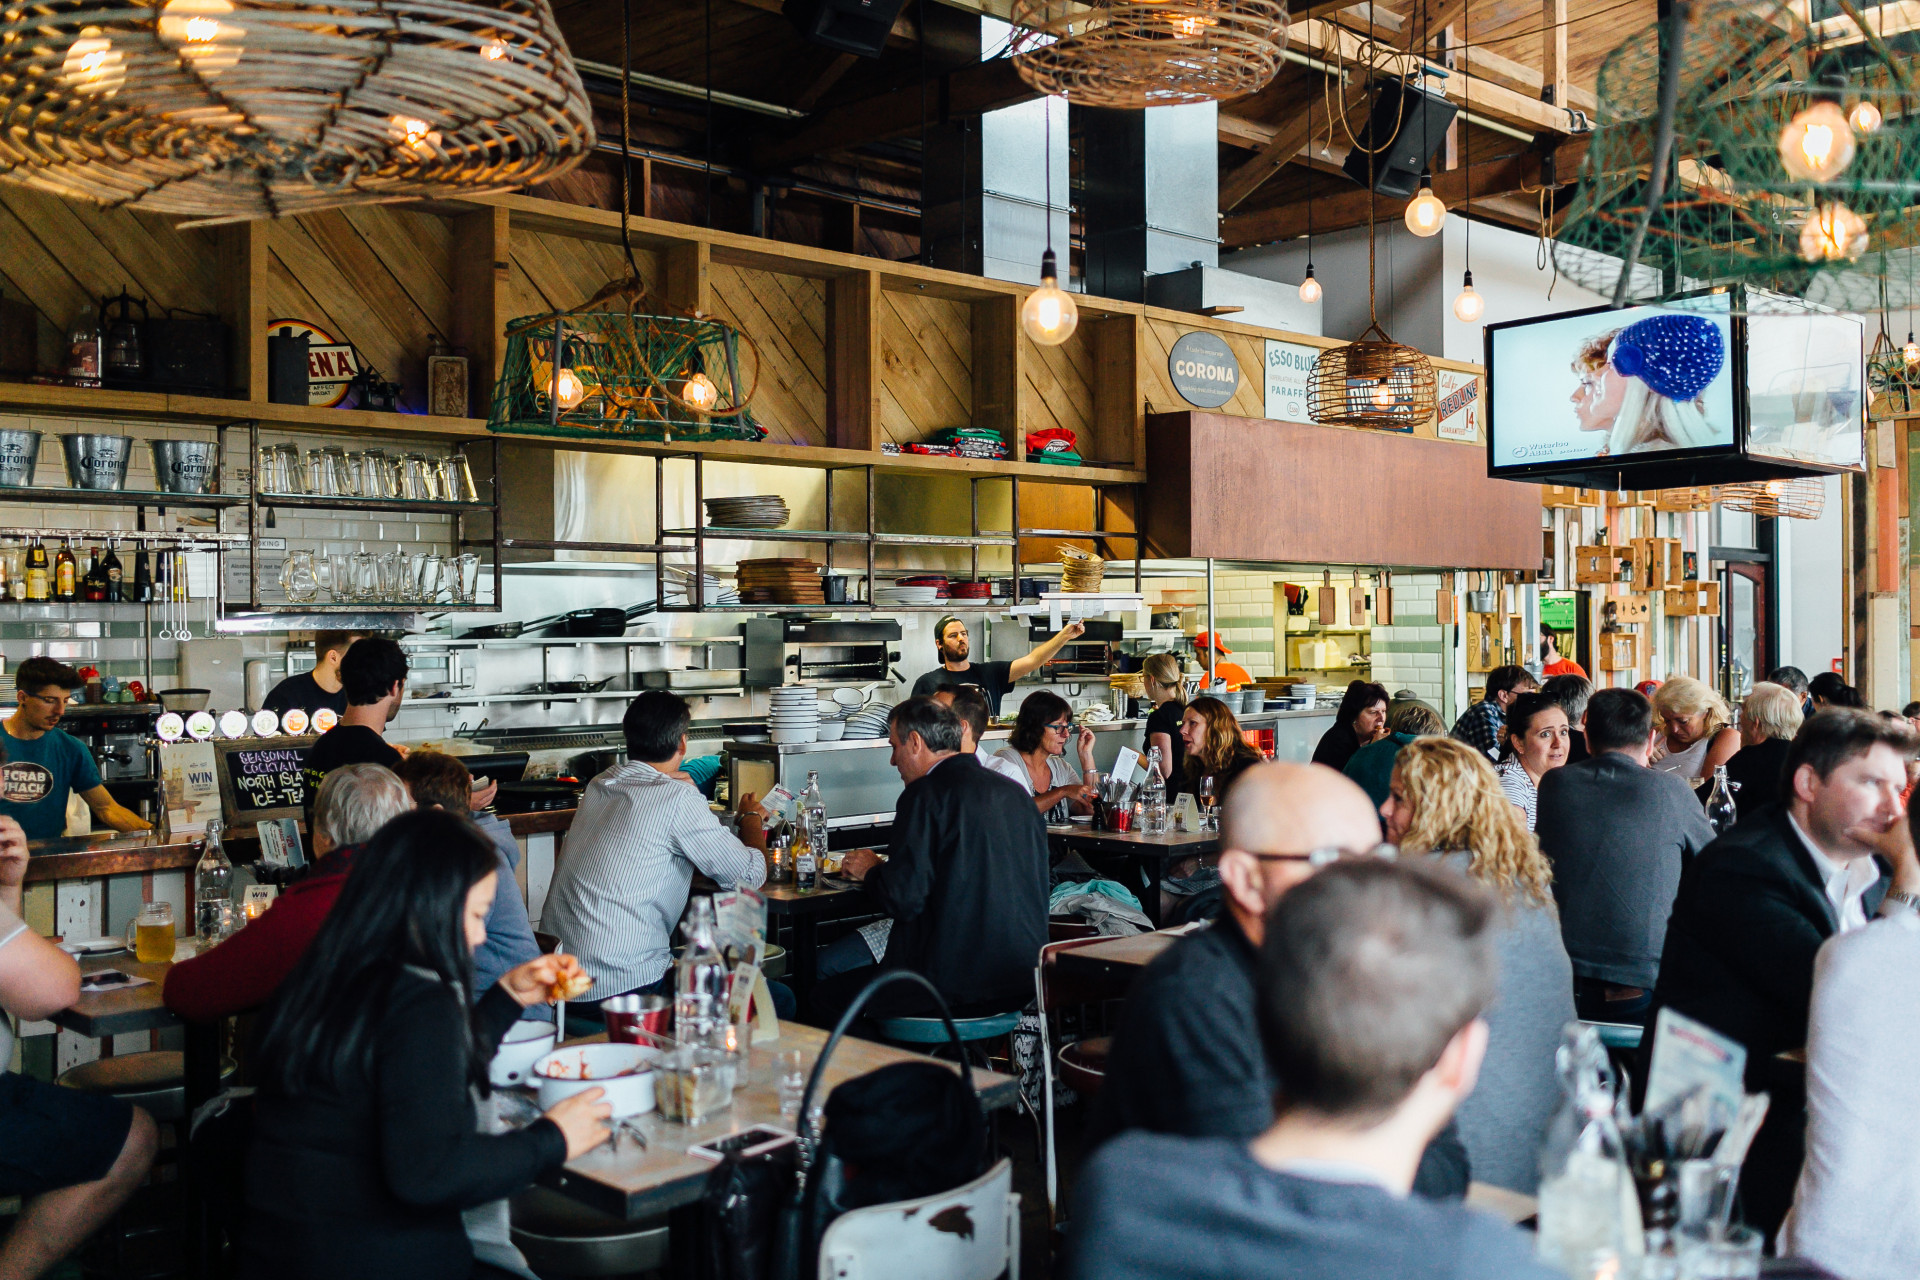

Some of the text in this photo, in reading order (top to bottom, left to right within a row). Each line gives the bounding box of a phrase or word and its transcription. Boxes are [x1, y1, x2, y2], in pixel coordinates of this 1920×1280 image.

[1268, 349, 1293, 368] ESSO
[1175, 359, 1235, 384] CORONA
[1440, 382, 1478, 418] REDLINE
[0, 455, 32, 465] orona
[81, 456, 126, 470] Corona
[171, 461, 211, 475] Corona
[239, 750, 304, 765] SEASONAL
[243, 761, 304, 774] COCKTAIL
[11, 770, 47, 782] CRAB
[188, 771, 213, 784] WIN
[237, 774, 277, 792] NORTH
[279, 771, 304, 787] ISLA
[251, 891, 268, 899] WIN
